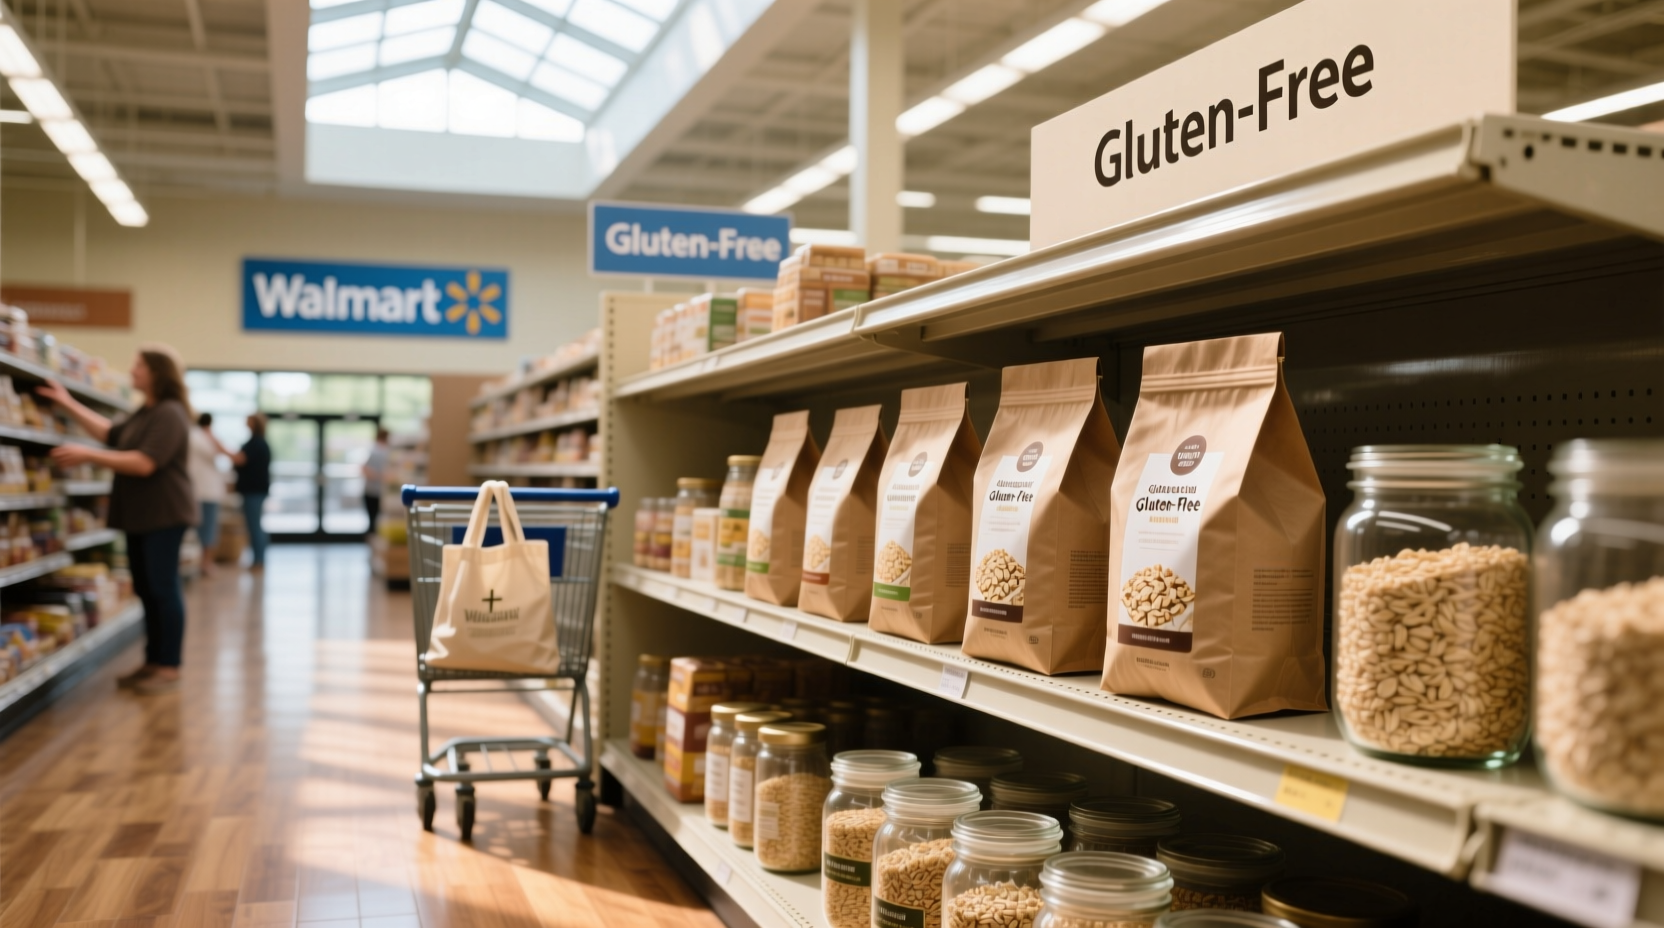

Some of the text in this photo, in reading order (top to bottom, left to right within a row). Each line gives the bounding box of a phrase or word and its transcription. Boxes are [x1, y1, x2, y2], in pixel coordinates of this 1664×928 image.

[1094, 44, 1374, 188] Gluten-Free
[605, 222, 782, 262] Gluten-Free
[253, 272, 441, 324] Walmart
